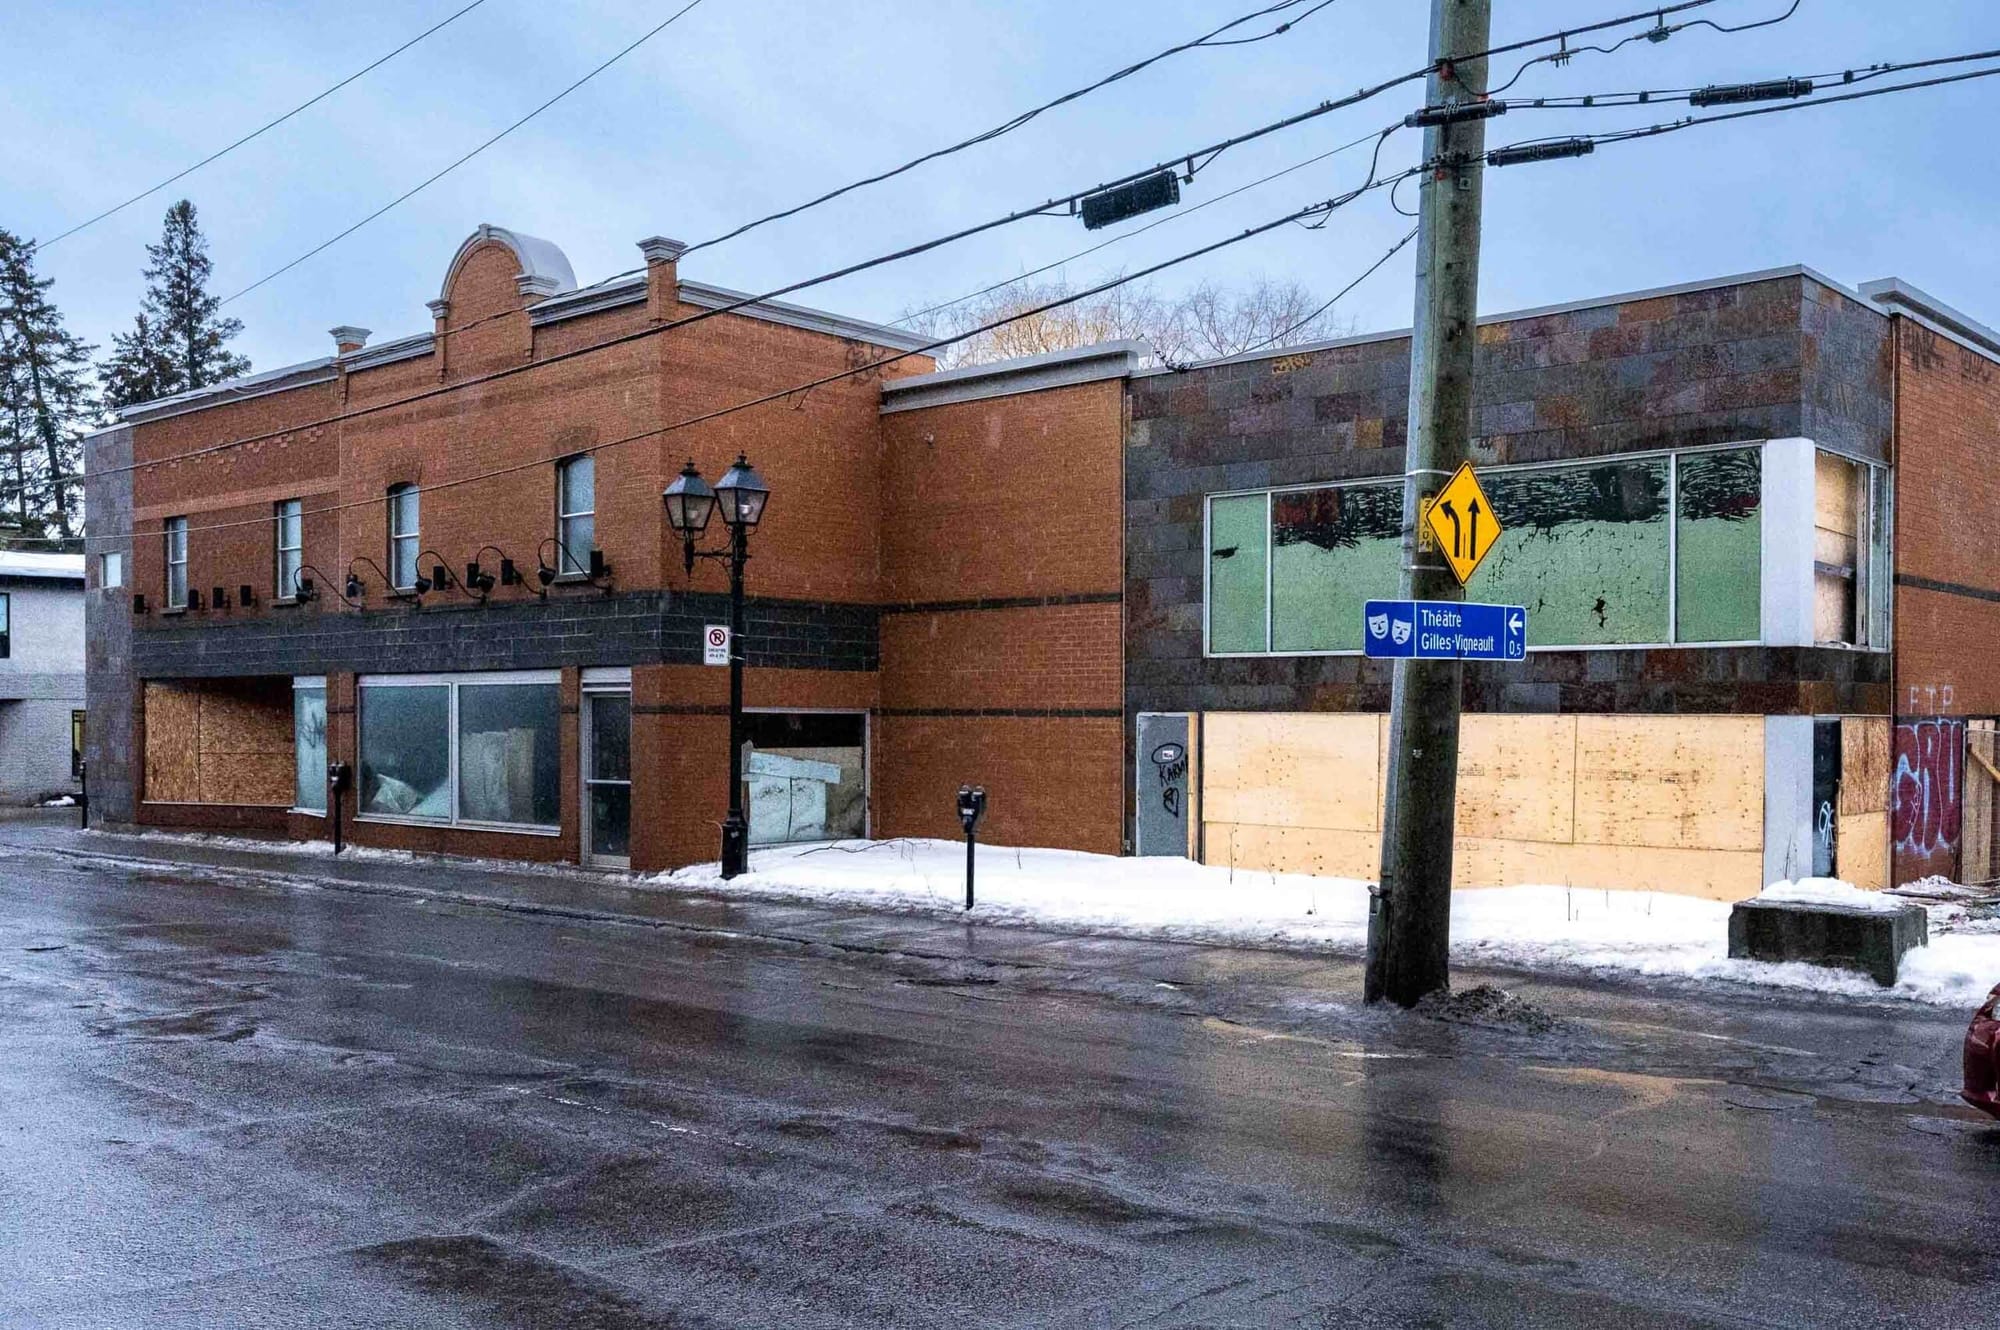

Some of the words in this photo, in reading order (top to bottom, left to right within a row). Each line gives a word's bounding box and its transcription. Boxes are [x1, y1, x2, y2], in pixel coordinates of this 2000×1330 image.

[1421, 609, 1462, 628] Théâtre
[1421, 633, 1494, 657] Gilles-Vigneault
[1909, 684, 1954, 715] FTP
